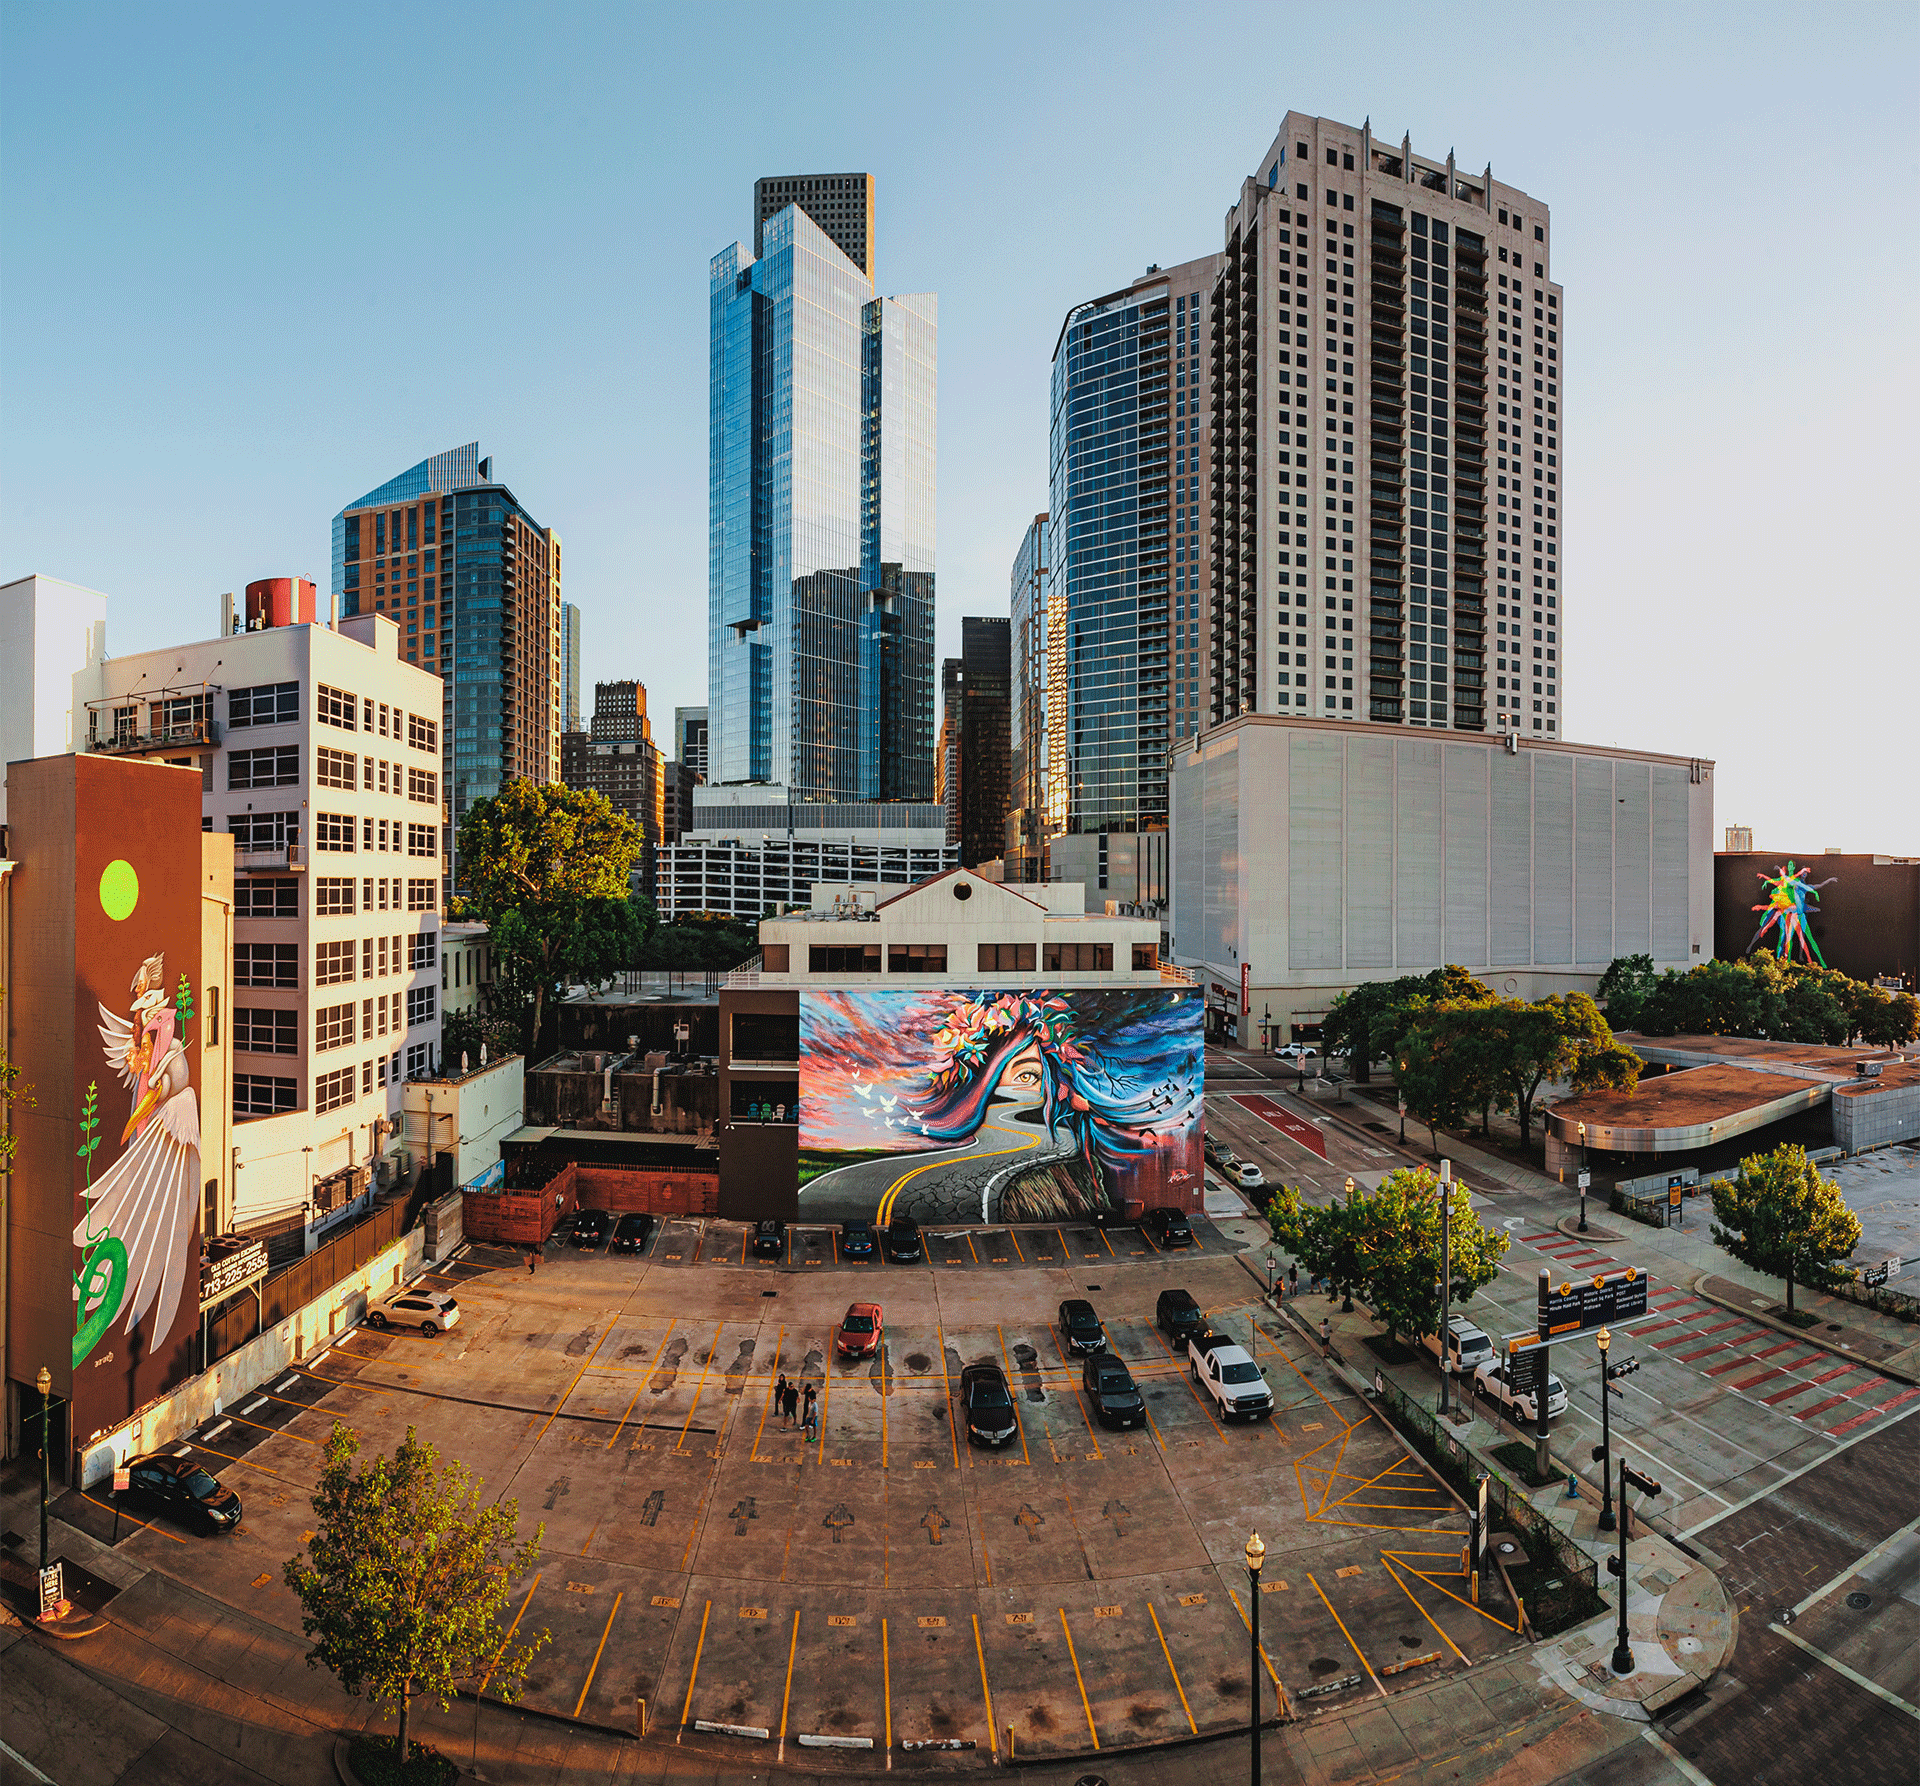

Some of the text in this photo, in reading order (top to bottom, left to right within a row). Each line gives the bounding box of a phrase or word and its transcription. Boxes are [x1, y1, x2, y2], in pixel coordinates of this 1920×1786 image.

[211, 1263, 221, 1273] OLD
[222, 1253, 240, 1267] COTTON
[204, 1252, 268, 1298] 713-225-2552
[1632, 1279, 1645, 1287] District
[1583, 1286, 1613, 1297] Historic District
[1564, 1294, 1579, 1302] County
[1583, 1303, 1602, 1311] Midtown
[1616, 1302, 1630, 1310] Central
[43, 1572, 58, 1582] PARK
[44, 1579, 59, 1589] HERE
